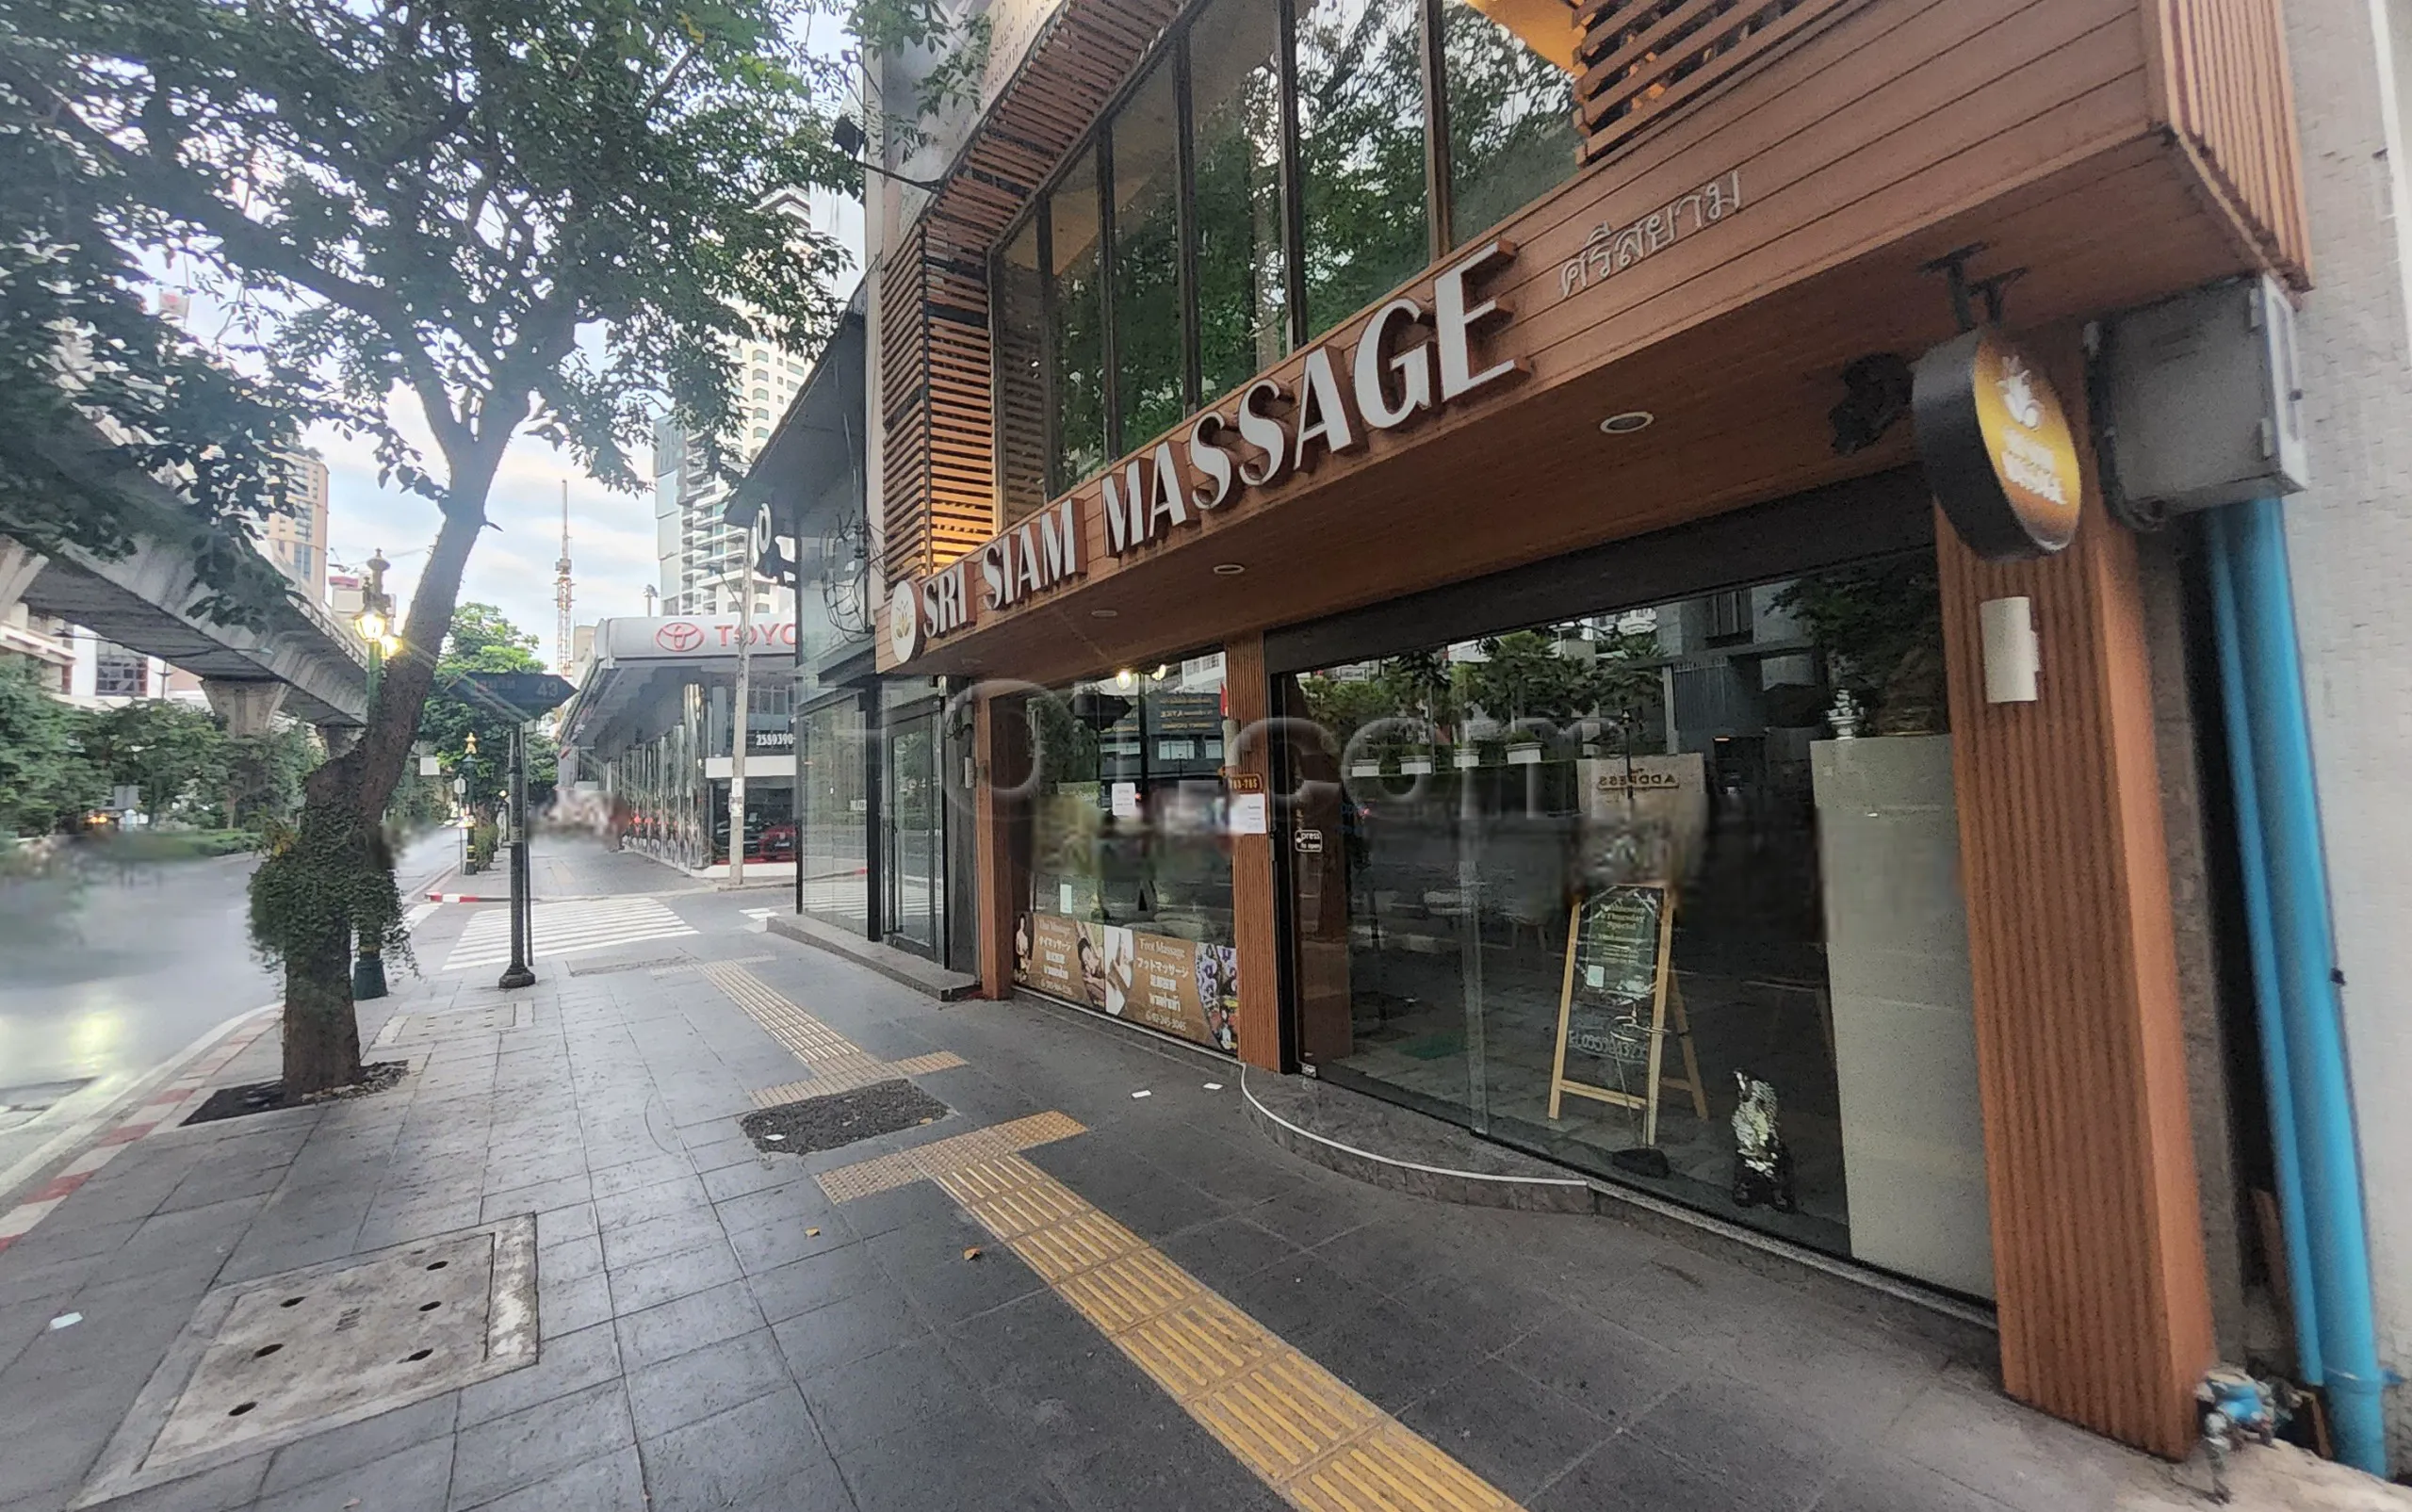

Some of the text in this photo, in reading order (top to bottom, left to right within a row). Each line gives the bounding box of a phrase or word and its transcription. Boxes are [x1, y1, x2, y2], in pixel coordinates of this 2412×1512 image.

[1560, 171, 1740, 298] ศรีสยาม
[923, 242, 1518, 640] SRI SIAM MASSAGE
[536, 682, 559, 698] 43
